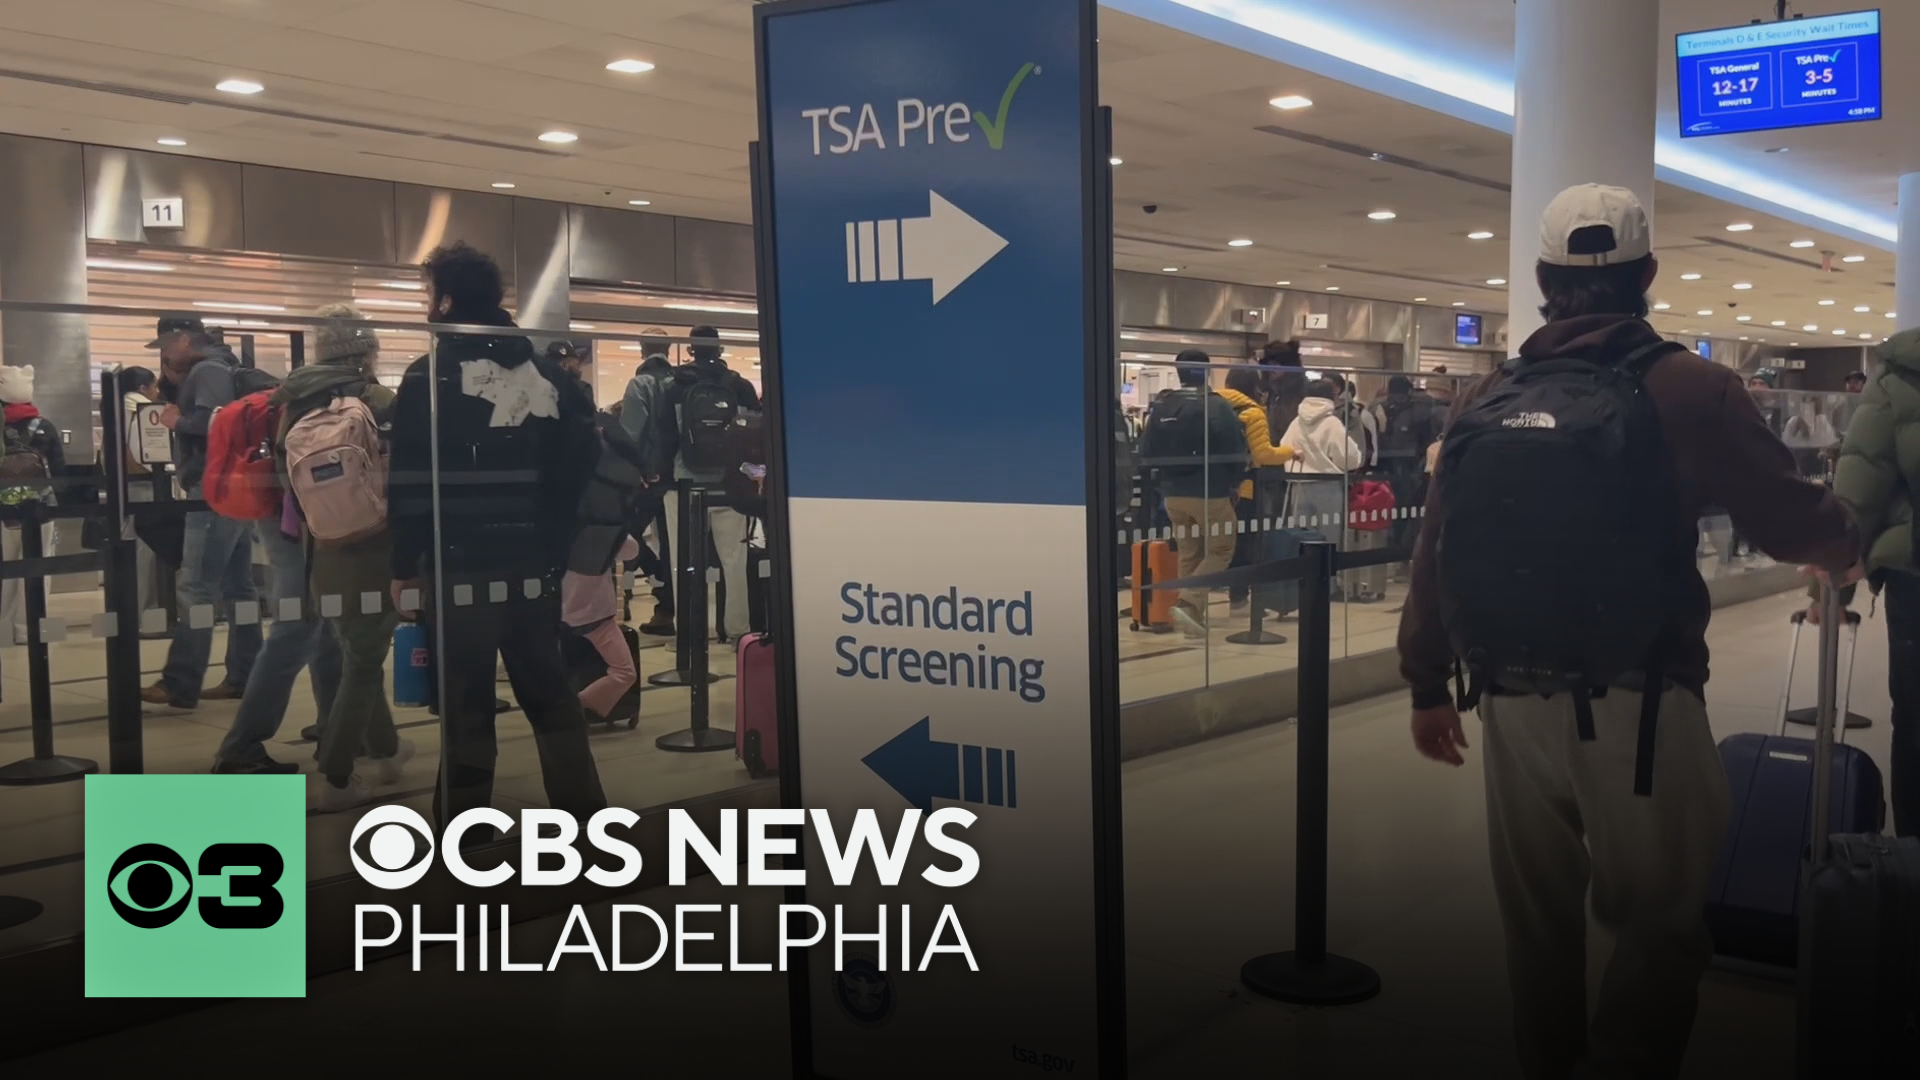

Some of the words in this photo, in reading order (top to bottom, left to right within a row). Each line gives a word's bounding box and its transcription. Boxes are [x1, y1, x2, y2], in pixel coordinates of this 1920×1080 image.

[1687, 36, 1734, 49] Terminals
[1737, 34, 1745, 43] D
[1747, 33, 1755, 42] &
[1757, 32, 1763, 40] E
[1765, 28, 1807, 40] Security
[1809, 24, 1835, 34] Wait
[1838, 20, 1869, 30] Times
[1796, 55, 1812, 65] TSA
[1813, 54, 1829, 63] Pre
[1709, 65, 1727, 75] TSA
[1727, 62, 1760, 73] General
[1805, 68, 1833, 85] 3-5
[1712, 77, 1759, 96] 12-17
[1801, 88, 1837, 98] MINUTES
[1718, 98, 1752, 107] MINUTES
[1863, 107, 1876, 115] PM
[802, 103, 886, 156] TSA
[897, 98, 971, 147] Pre
[152, 204, 172, 221] 11
[1313, 317, 1320, 326] 7
[840, 581, 1033, 636] Standard
[835, 635, 1046, 703] Screening
[1011, 1043, 1075, 1074] tsa.gov
